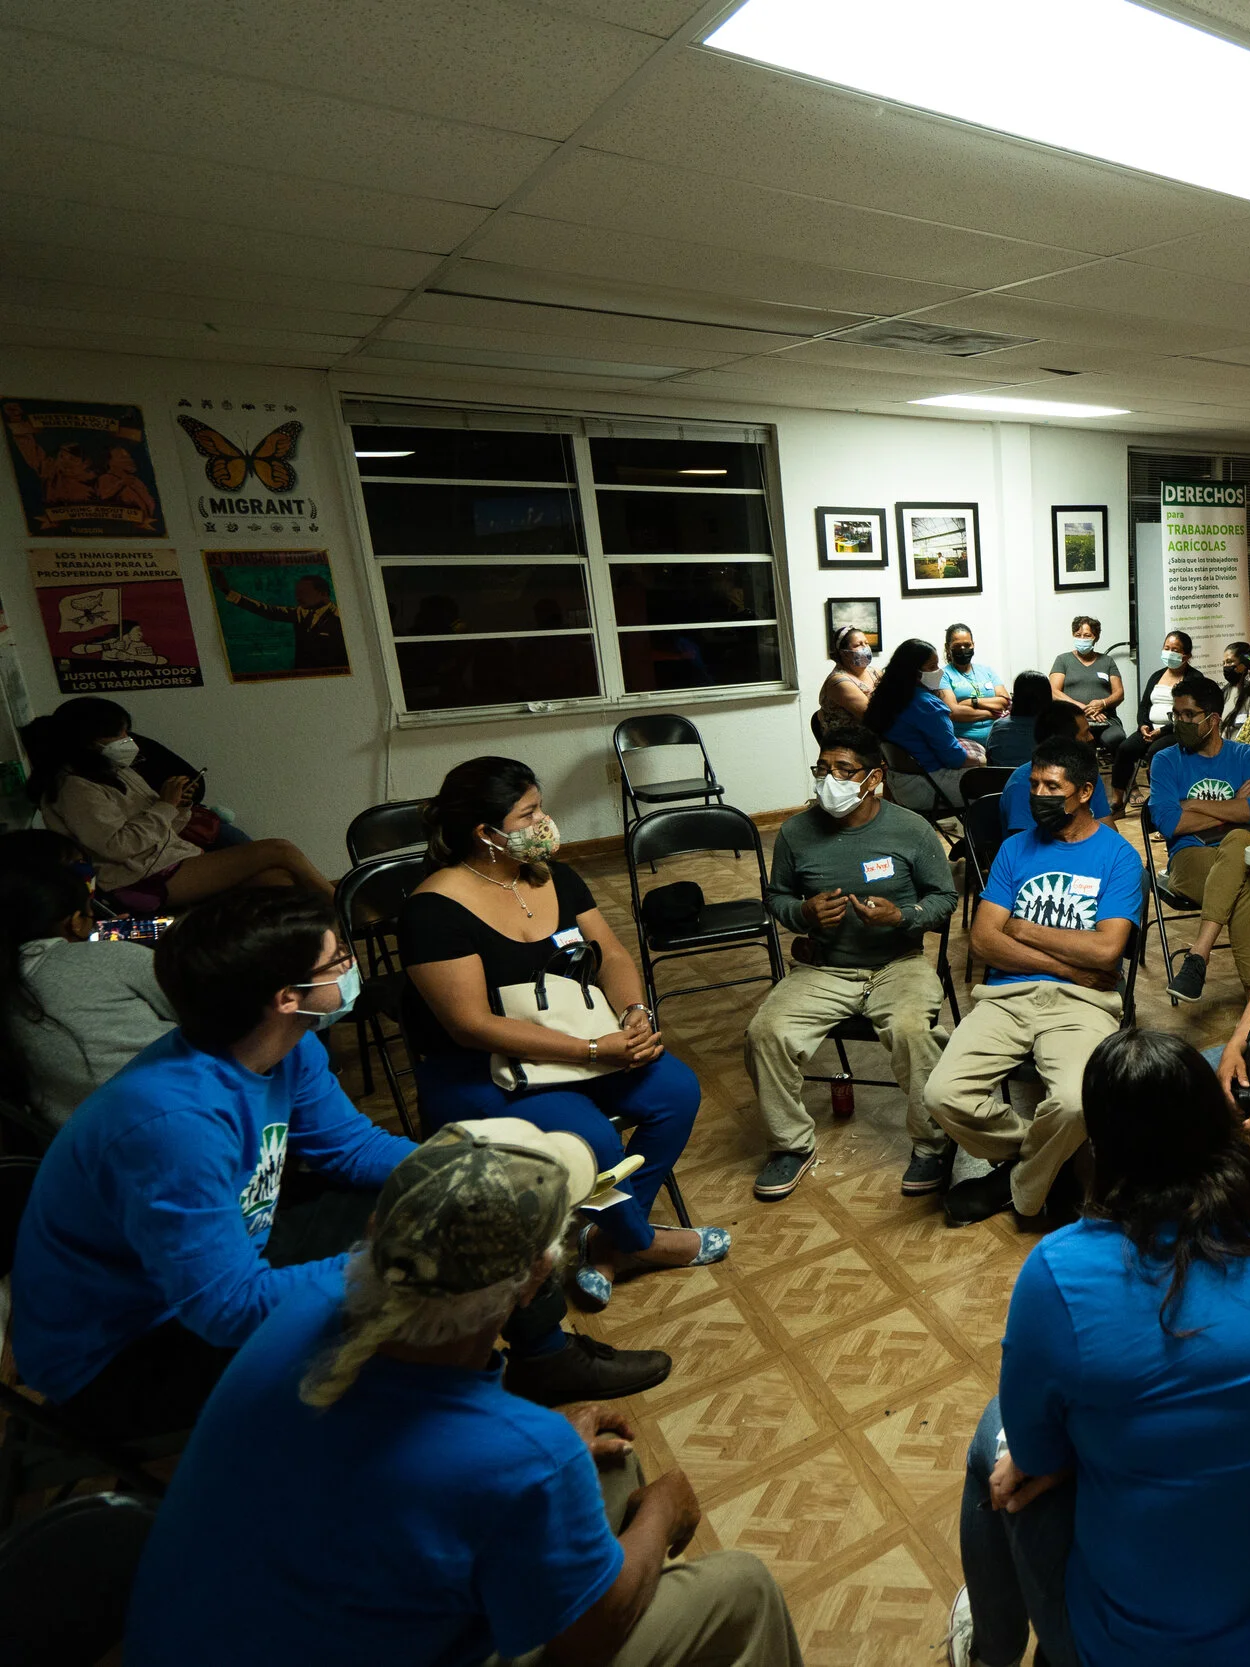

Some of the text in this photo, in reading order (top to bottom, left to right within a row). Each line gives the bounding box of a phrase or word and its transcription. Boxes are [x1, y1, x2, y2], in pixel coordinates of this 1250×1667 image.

[1165, 485, 1244, 504] DERECHOS
[209, 498, 305, 515] MIGRANT
[1166, 511, 1184, 520] para
[1167, 524, 1245, 535] TRABAJADORES
[1168, 539, 1227, 551] AGRÍCOLAS
[1206, 556, 1239, 564] trabajadores
[37, 570, 113, 578] PROSPERIDAD
[1169, 593, 1224, 601] independientemente
[1191, 602, 1221, 610] migratorio?
[63, 667, 197, 681] JUSTICIA PARA TODOS
[72, 677, 193, 691] LOS TRABAJADORES
